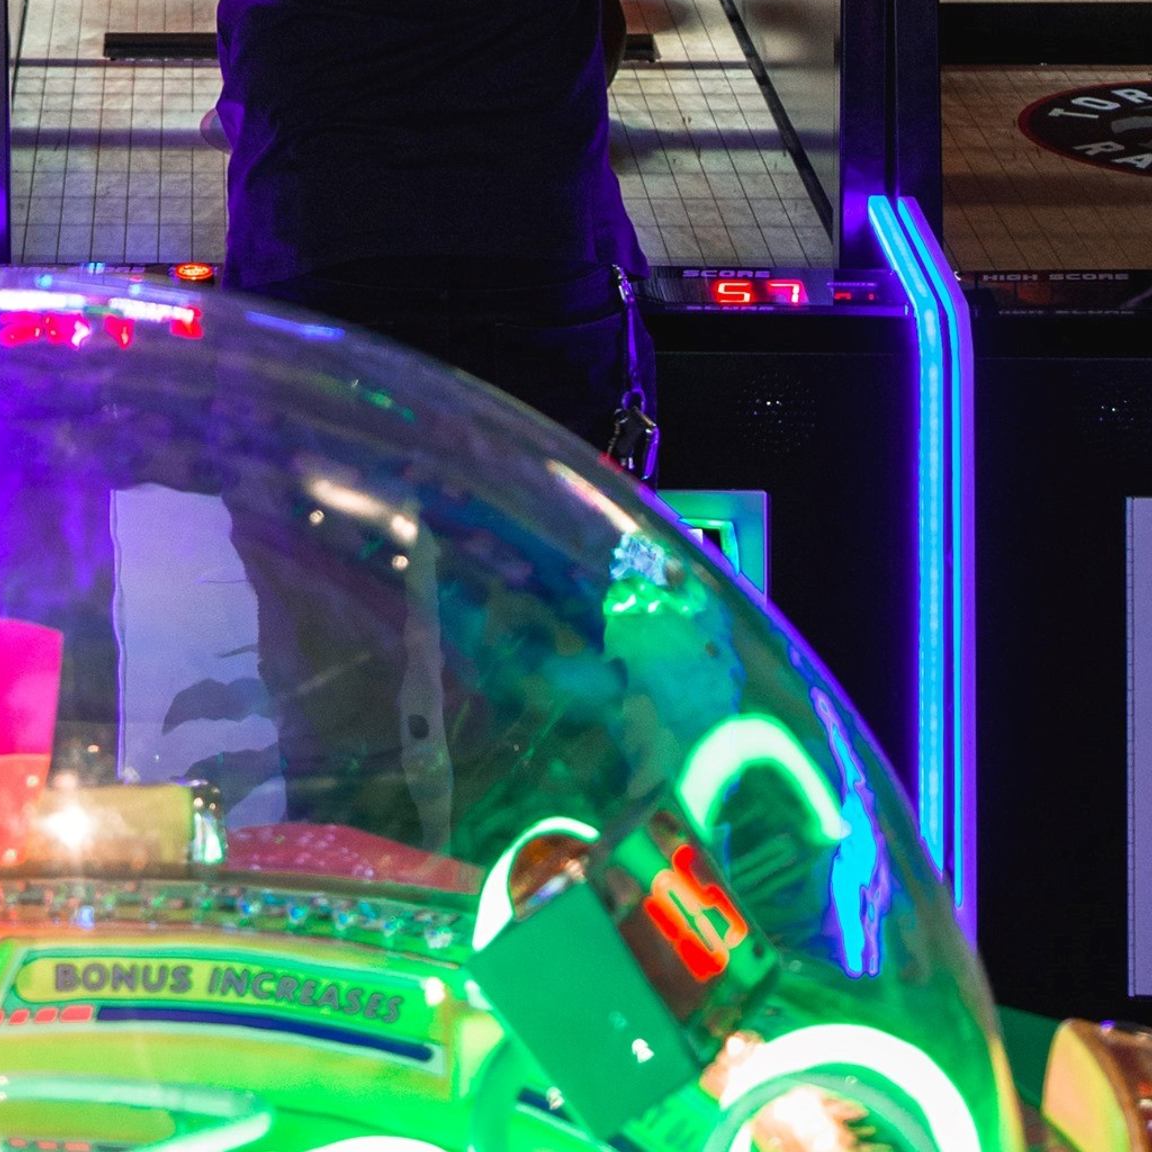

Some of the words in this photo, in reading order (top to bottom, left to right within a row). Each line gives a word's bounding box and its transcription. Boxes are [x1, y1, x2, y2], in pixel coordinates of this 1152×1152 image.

[681, 269, 771, 278] SCORE
[982, 273, 1039, 281] HIGH
[1048, 273, 1130, 281] SCORE
[716, 281, 801, 304] 57
[54, 962, 193, 994] BONUS
[207, 966, 404, 1024] INCREASES
